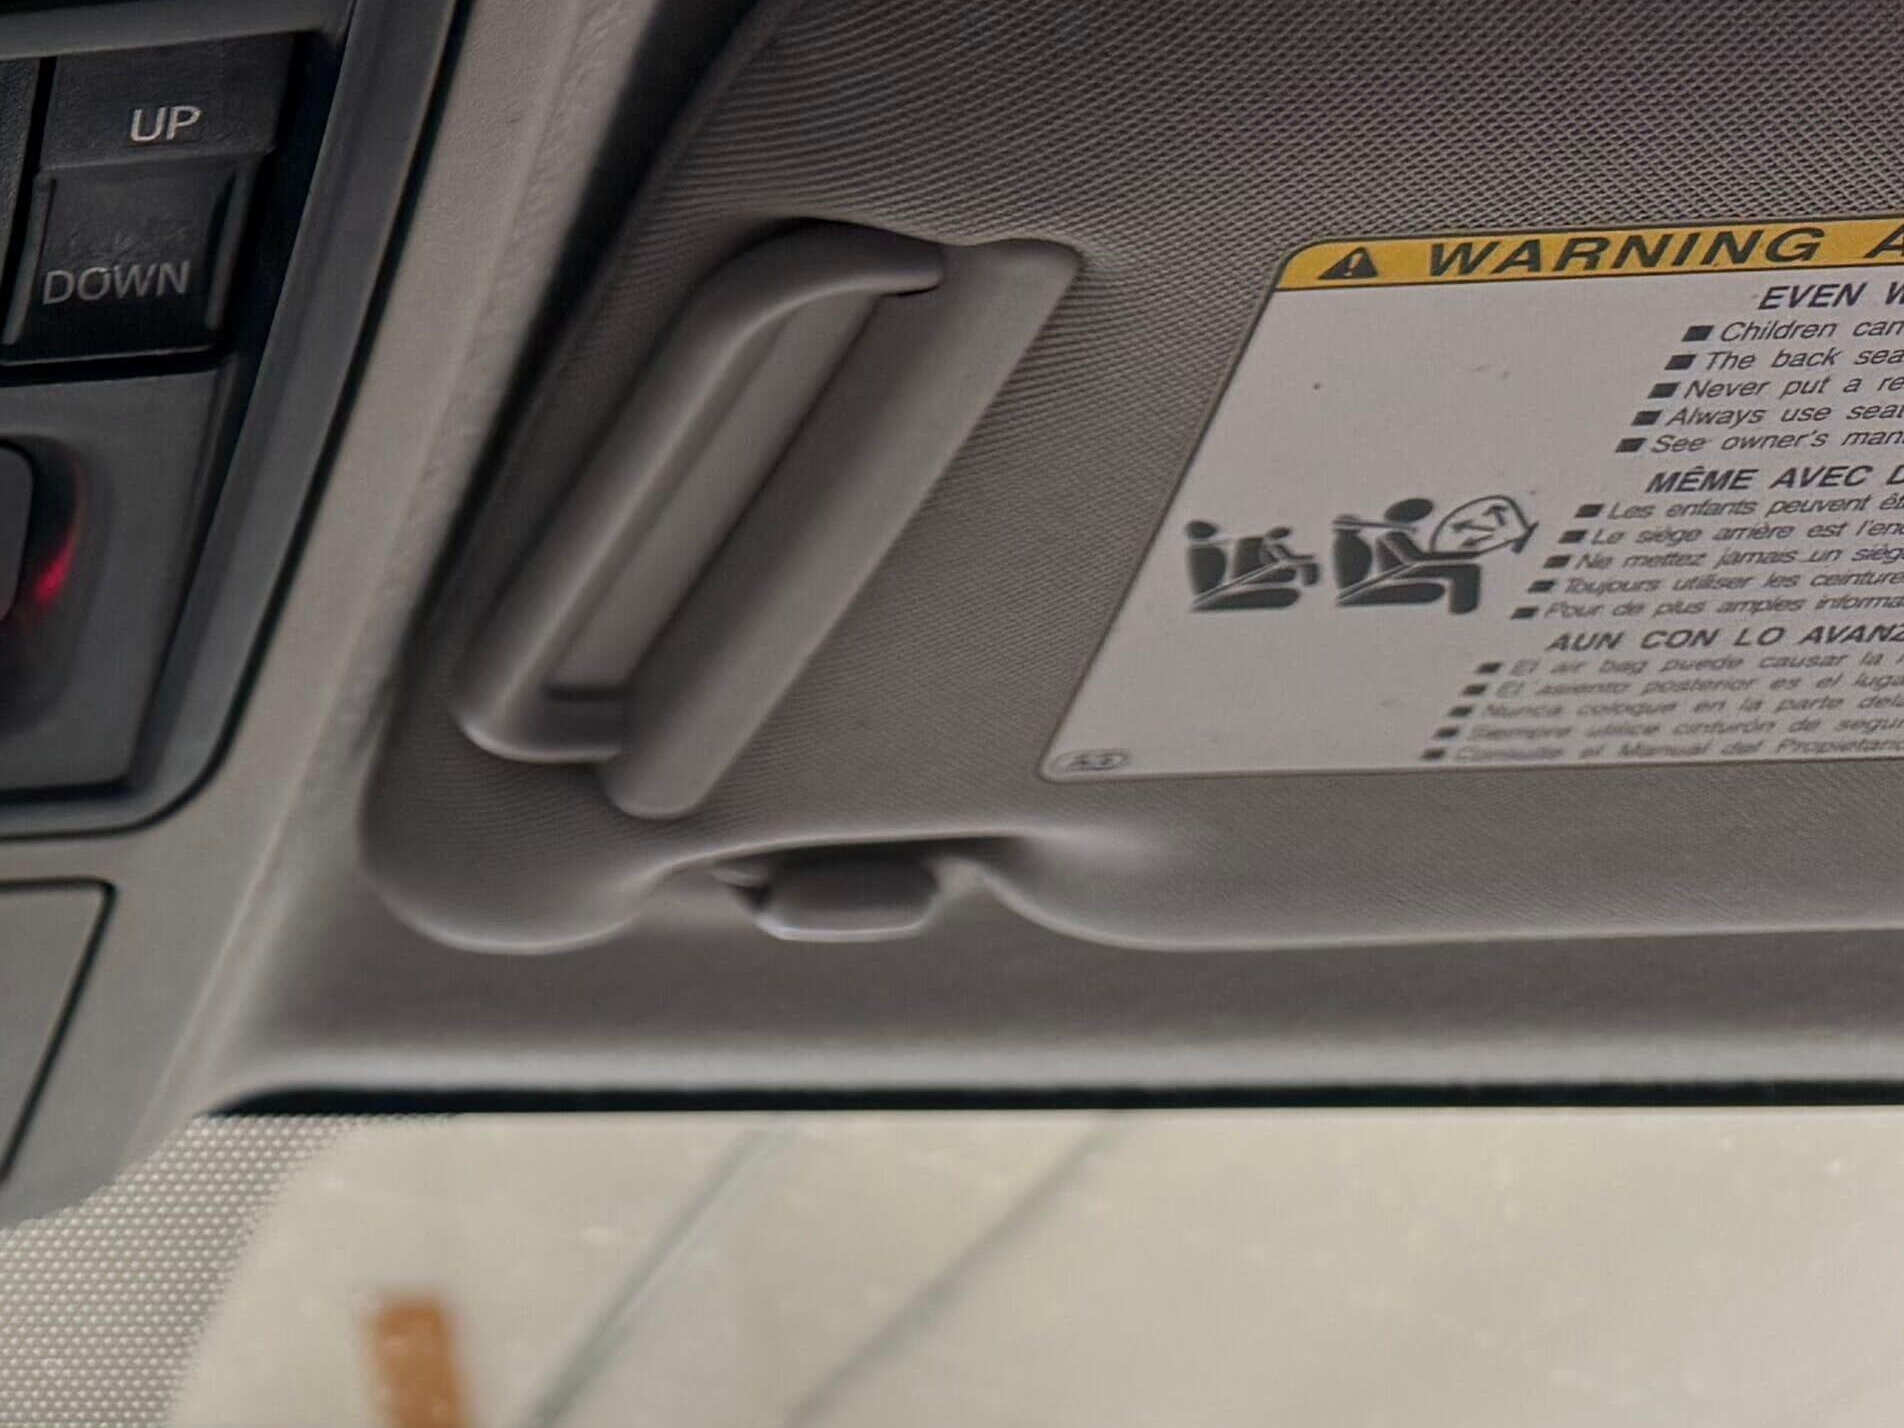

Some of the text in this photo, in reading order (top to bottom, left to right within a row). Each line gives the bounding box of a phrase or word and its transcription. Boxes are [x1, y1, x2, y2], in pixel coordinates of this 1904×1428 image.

[128, 104, 203, 145] UP
[1430, 227, 1825, 276] WARNING
[42, 260, 191, 306] DOWN
[1758, 281, 1869, 310] EVEN
[1720, 319, 1838, 342] Children
[1705, 350, 1756, 371] The
[1771, 347, 1843, 368] back
[1683, 379, 1771, 400] Never
[1778, 375, 1832, 401] put
[1843, 377, 1862, 393] a
[1665, 406, 1767, 429] Always
[1780, 405, 1832, 422] use
[1651, 434, 1707, 453] See
[1720, 429, 1830, 451] owner's
[1645, 465, 1759, 493] MÊME
[1769, 464, 1874, 489] AVEC
[1607, 502, 1656, 520] Les
[1666, 498, 1758, 518] enfants
[1765, 494, 1872, 518] peuvent
[1592, 528, 1626, 545] Le
[1807, 521, 1849, 539] est
[1574, 552, 1614, 570] Ne
[1622, 551, 1708, 569] mettez
[1712, 545, 1799, 570] jamais
[1807, 548, 1843, 563] un
[1564, 576, 1662, 596] Toujours
[1764, 571, 1802, 589] les
[1545, 600, 1603, 619] Pour
[1612, 600, 1645, 618] de
[1653, 598, 1707, 620] plus
[1716, 595, 1808, 615] amples
[1546, 631, 1623, 652] AUN
[1640, 628, 1720, 649] CON
[1733, 625, 1785, 647] LO
